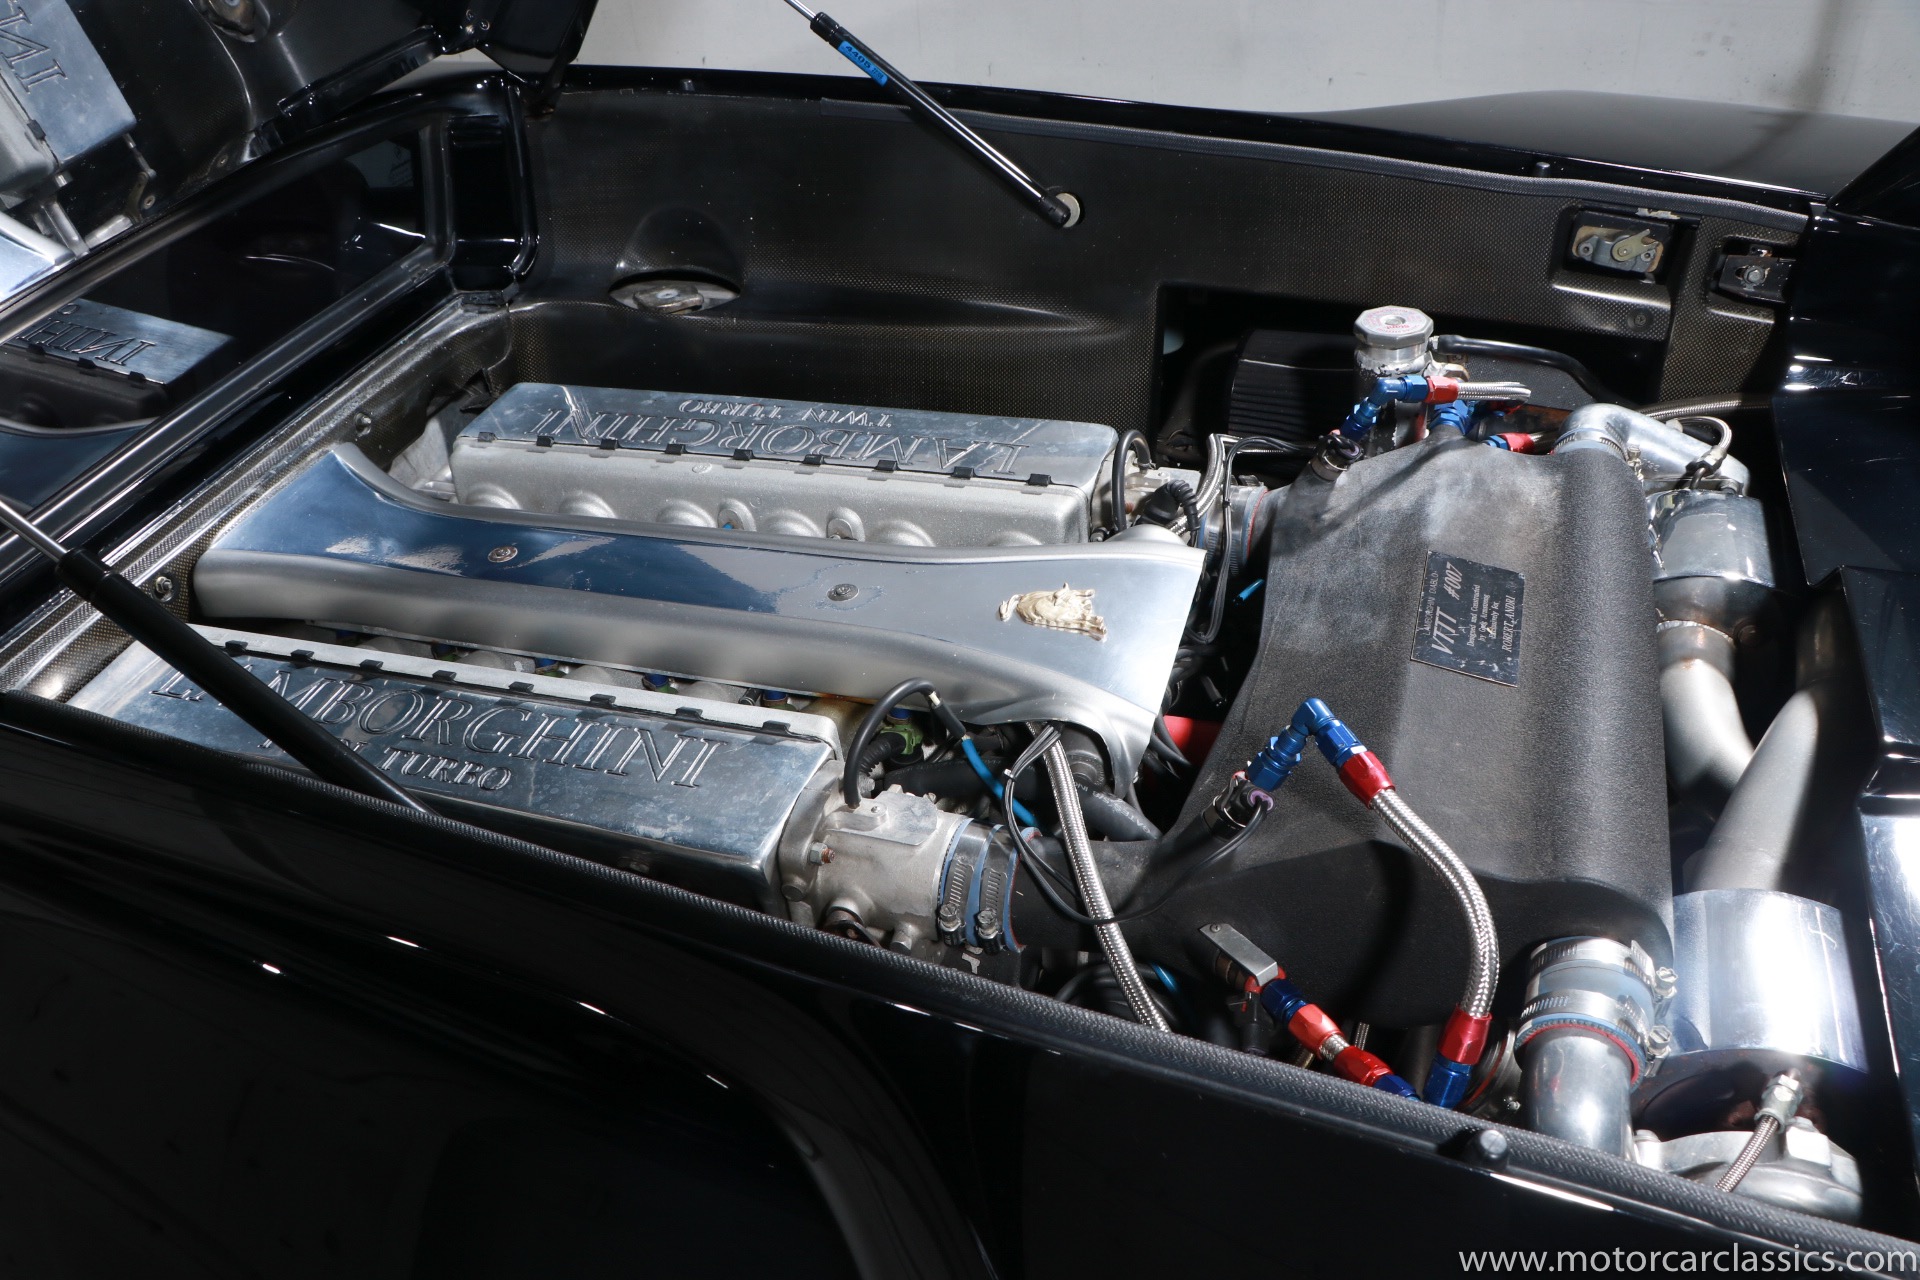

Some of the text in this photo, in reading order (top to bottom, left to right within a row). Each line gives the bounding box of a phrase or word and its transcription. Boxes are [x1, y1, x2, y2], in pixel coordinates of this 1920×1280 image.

[679, 399, 895, 427] TWIN TURBO
[523, 407, 1029, 475] LAMBORGHINI
[1443, 561, 1463, 600] #007
[1470, 584, 1481, 612] Constructed
[1491, 601, 1500, 610] for
[1467, 624, 1477, 647] Designed
[1501, 620, 1515, 652] ROBERT
[149, 664, 728, 788] LMBORGHINI
[378, 746, 512, 791] TURBO
